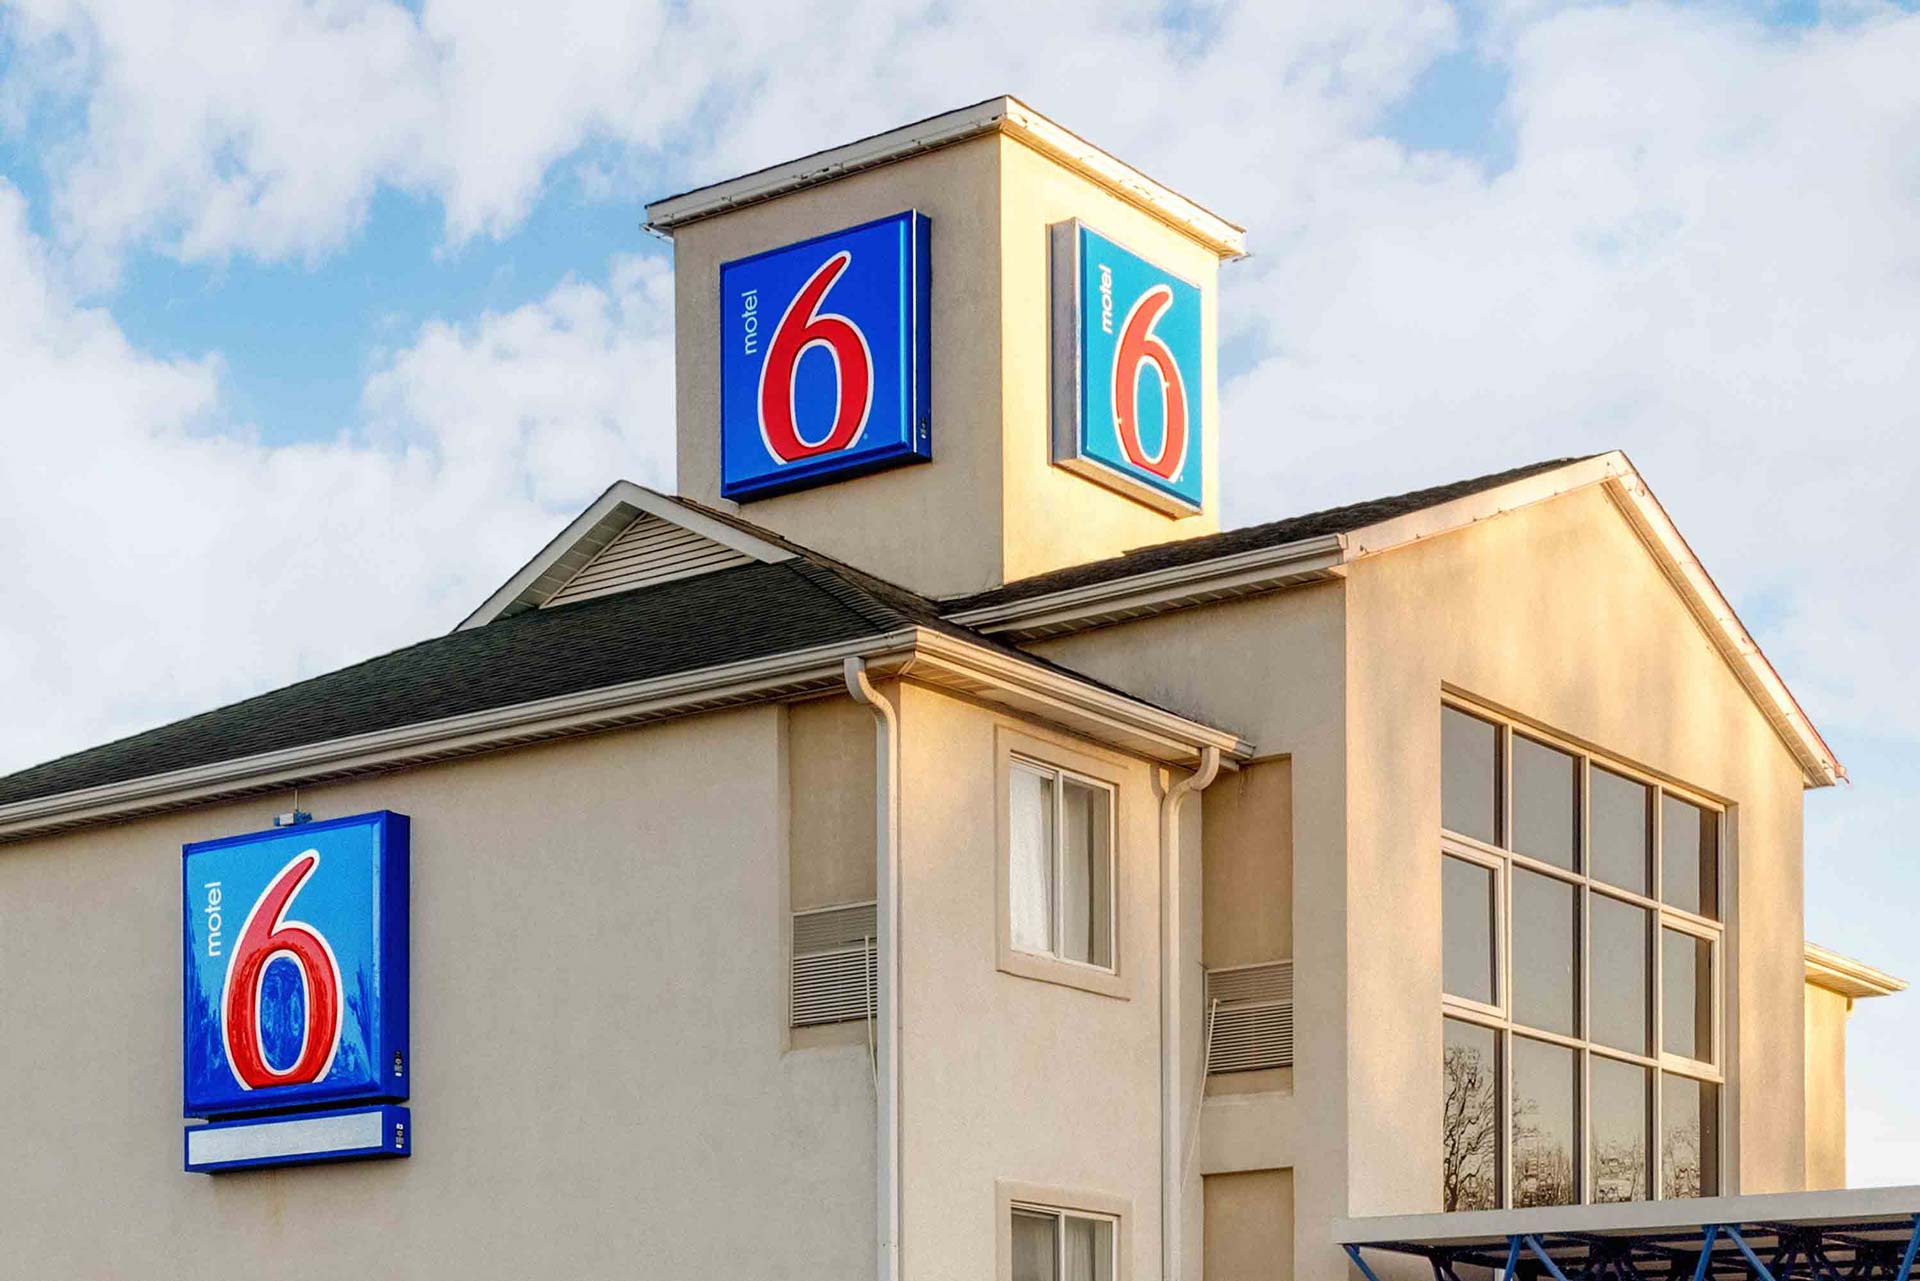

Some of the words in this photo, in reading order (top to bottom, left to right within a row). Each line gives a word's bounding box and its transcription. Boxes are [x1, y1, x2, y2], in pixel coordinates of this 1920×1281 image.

[741, 289, 758, 356] motel
[757, 250, 875, 466] 6
[1098, 264, 1113, 335] motel
[1110, 284, 1190, 485] 6
[204, 881, 222, 957] motel
[220, 848, 344, 1092] 6
